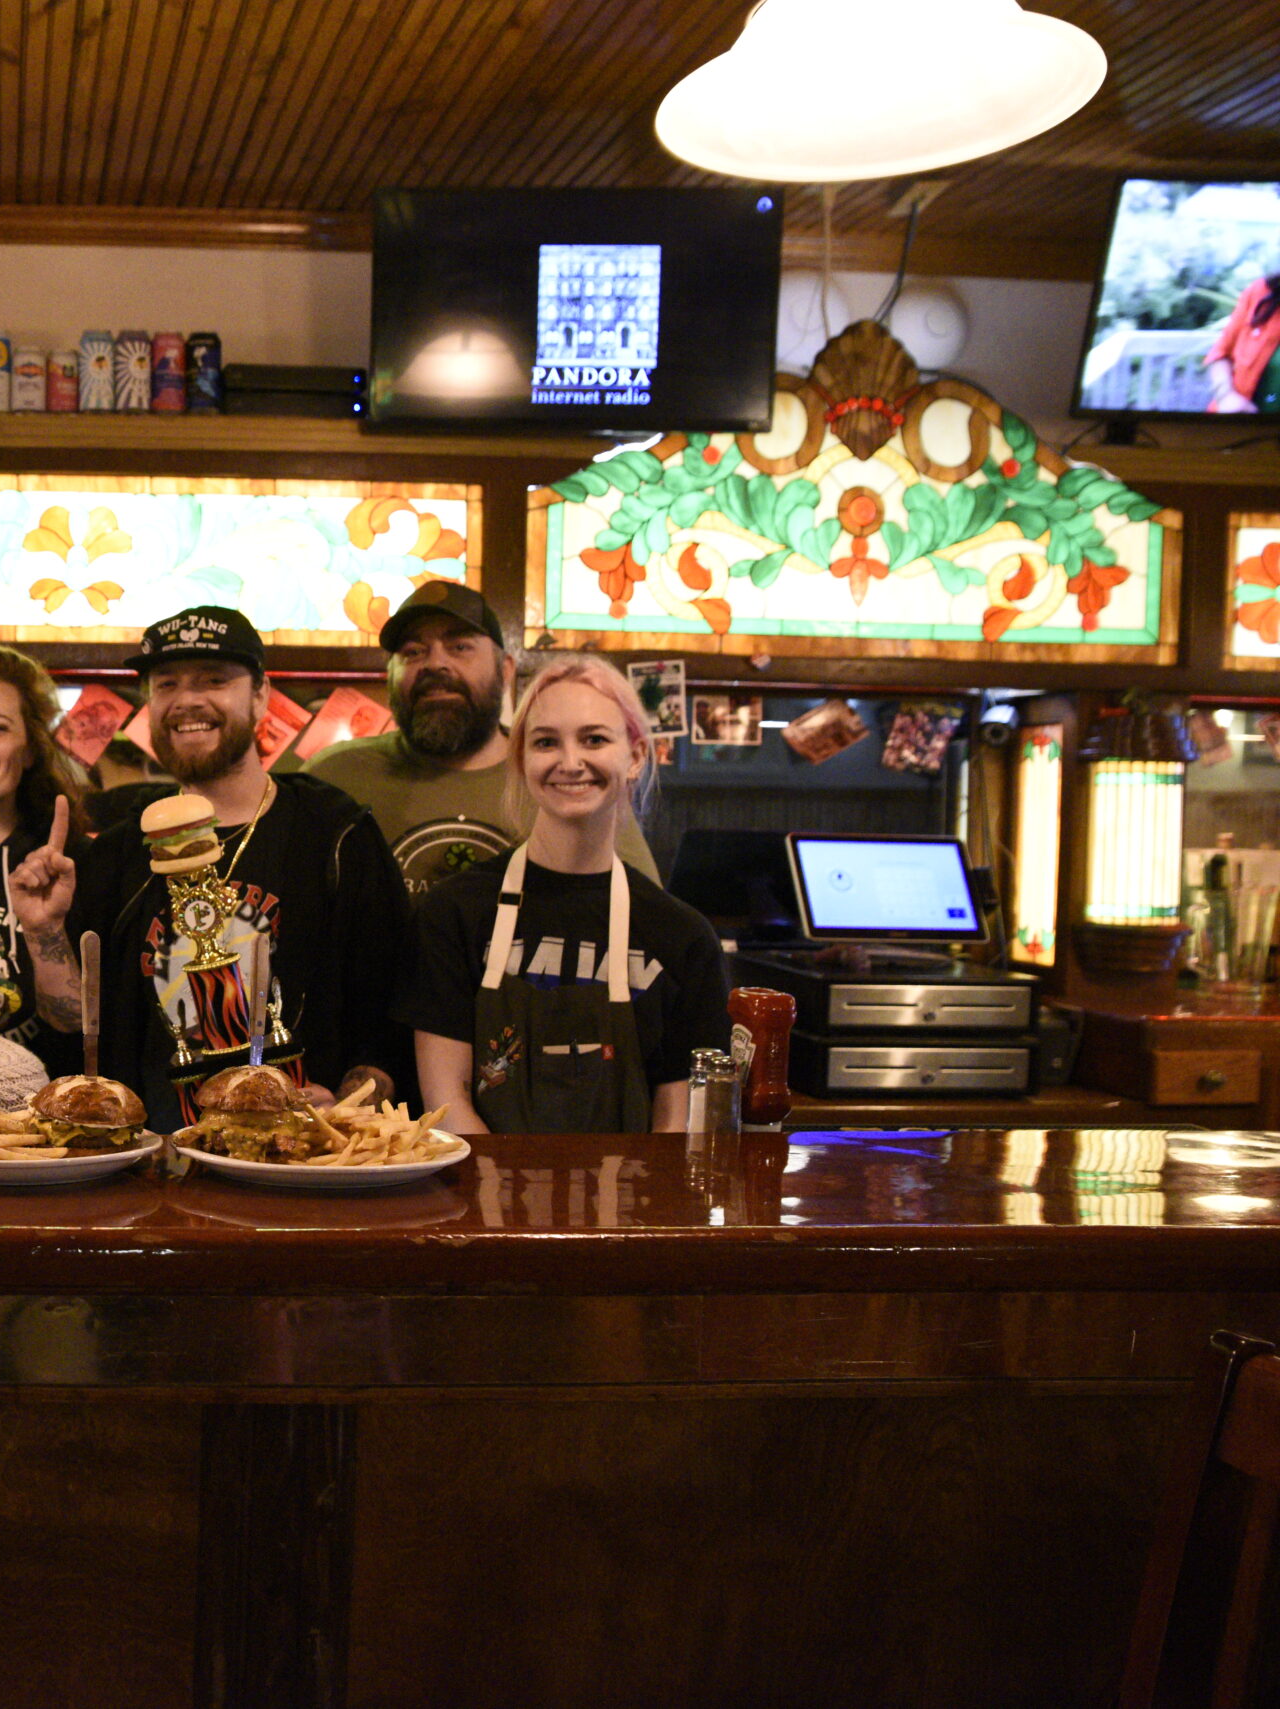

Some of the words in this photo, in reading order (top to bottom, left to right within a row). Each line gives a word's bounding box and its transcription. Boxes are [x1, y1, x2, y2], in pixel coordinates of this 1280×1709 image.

[531, 366, 650, 386] PANDORA
[531, 387, 601, 404] internet
[604, 386, 651, 405] radio
[157, 615, 228, 635] WU-TANG
